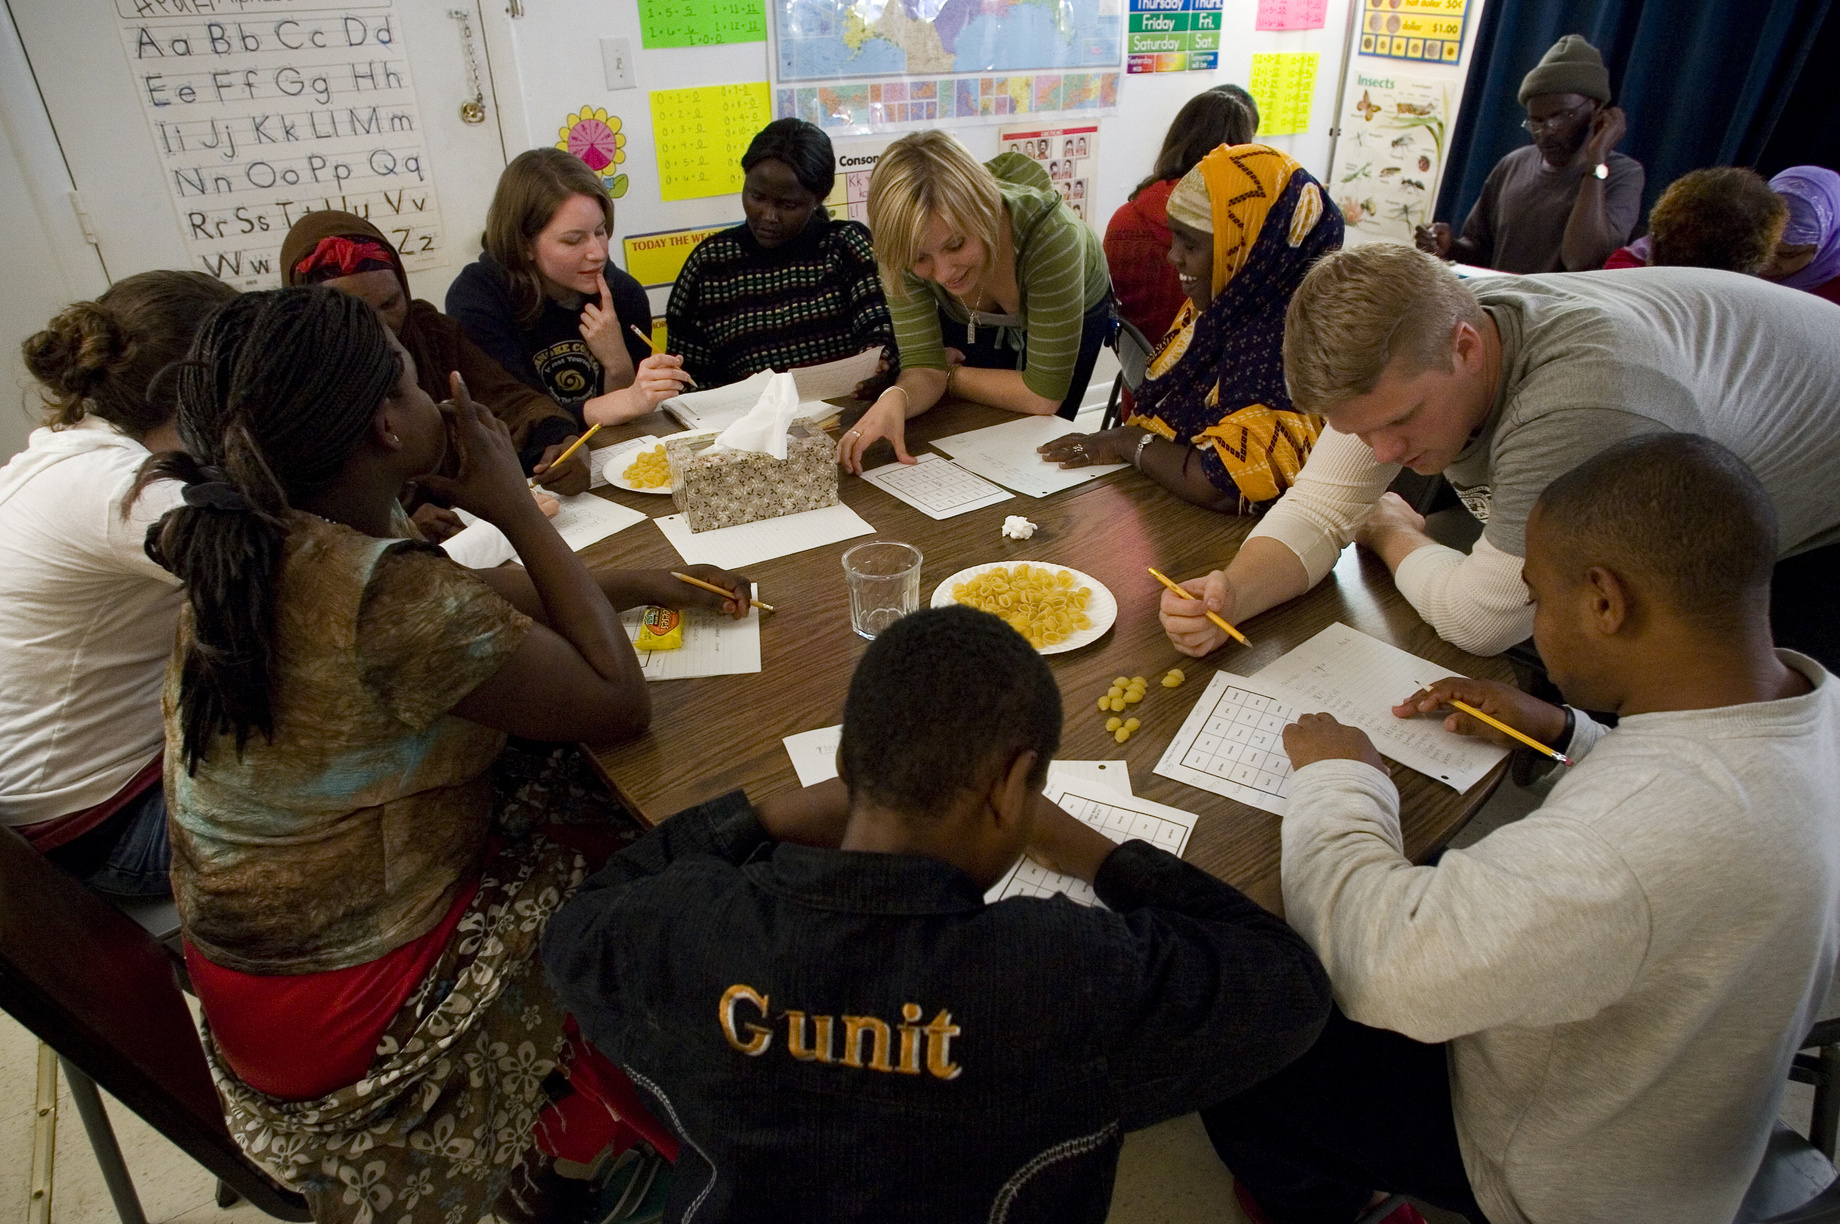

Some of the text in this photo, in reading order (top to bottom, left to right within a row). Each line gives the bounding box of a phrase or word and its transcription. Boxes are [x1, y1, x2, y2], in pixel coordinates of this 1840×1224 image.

[1142, 13, 1215, 31] Friday Fri.
[1432, 23, 1458, 34] $1.00
[1133, 33, 1215, 51] Saturday Sat.
[1357, 74, 1395, 89] Insects
[632, 239, 667, 252] TODAY
[669, 235, 689, 247] THE
